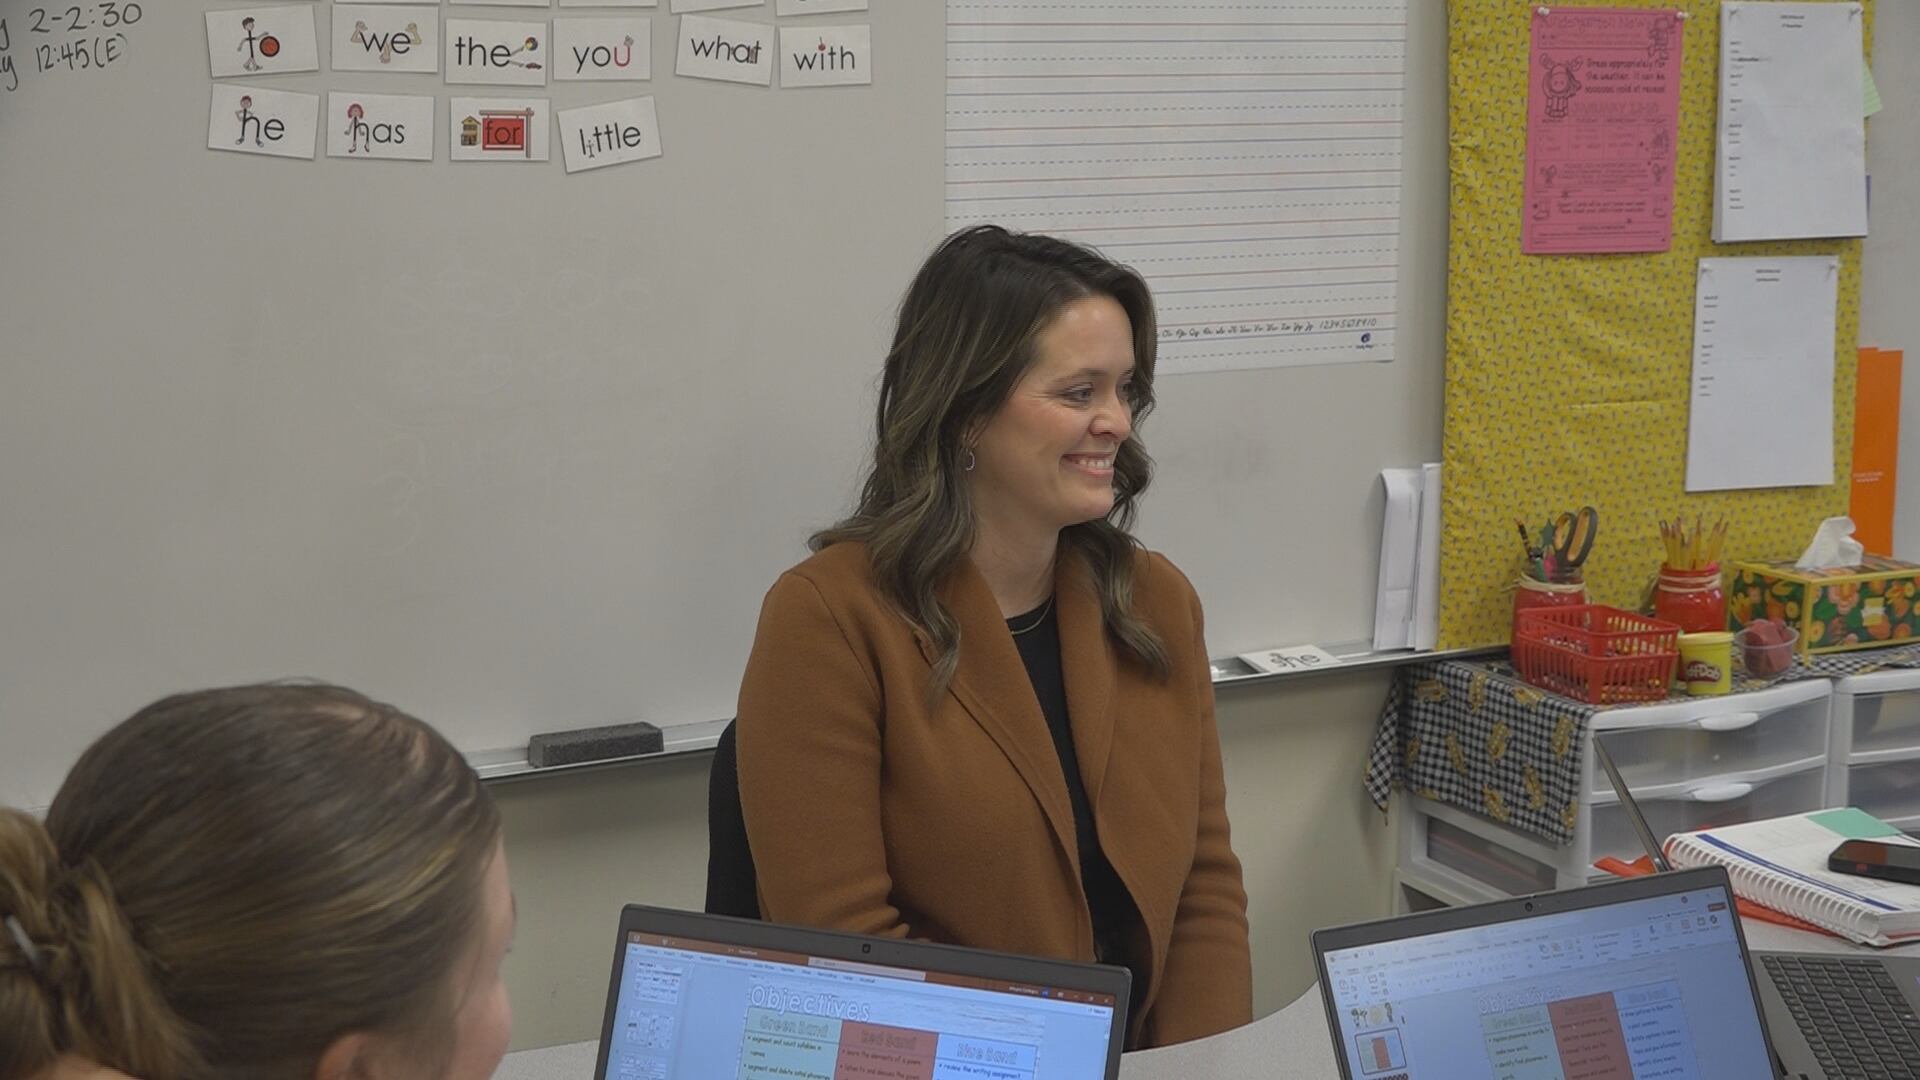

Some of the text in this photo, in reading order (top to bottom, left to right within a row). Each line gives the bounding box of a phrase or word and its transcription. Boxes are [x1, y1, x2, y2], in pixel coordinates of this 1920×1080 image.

[28, 2, 142, 33] 2-2:30
[359, 29, 412, 54] we
[454, 35, 512, 68] the
[690, 35, 762, 66] what
[793, 41, 856, 71] with
[573, 43, 632, 73] you
[241, 107, 285, 144] he
[351, 114, 406, 149] has
[484, 121, 522, 145] for
[578, 122, 642, 158] little
[751, 984, 871, 1021] Objectives
